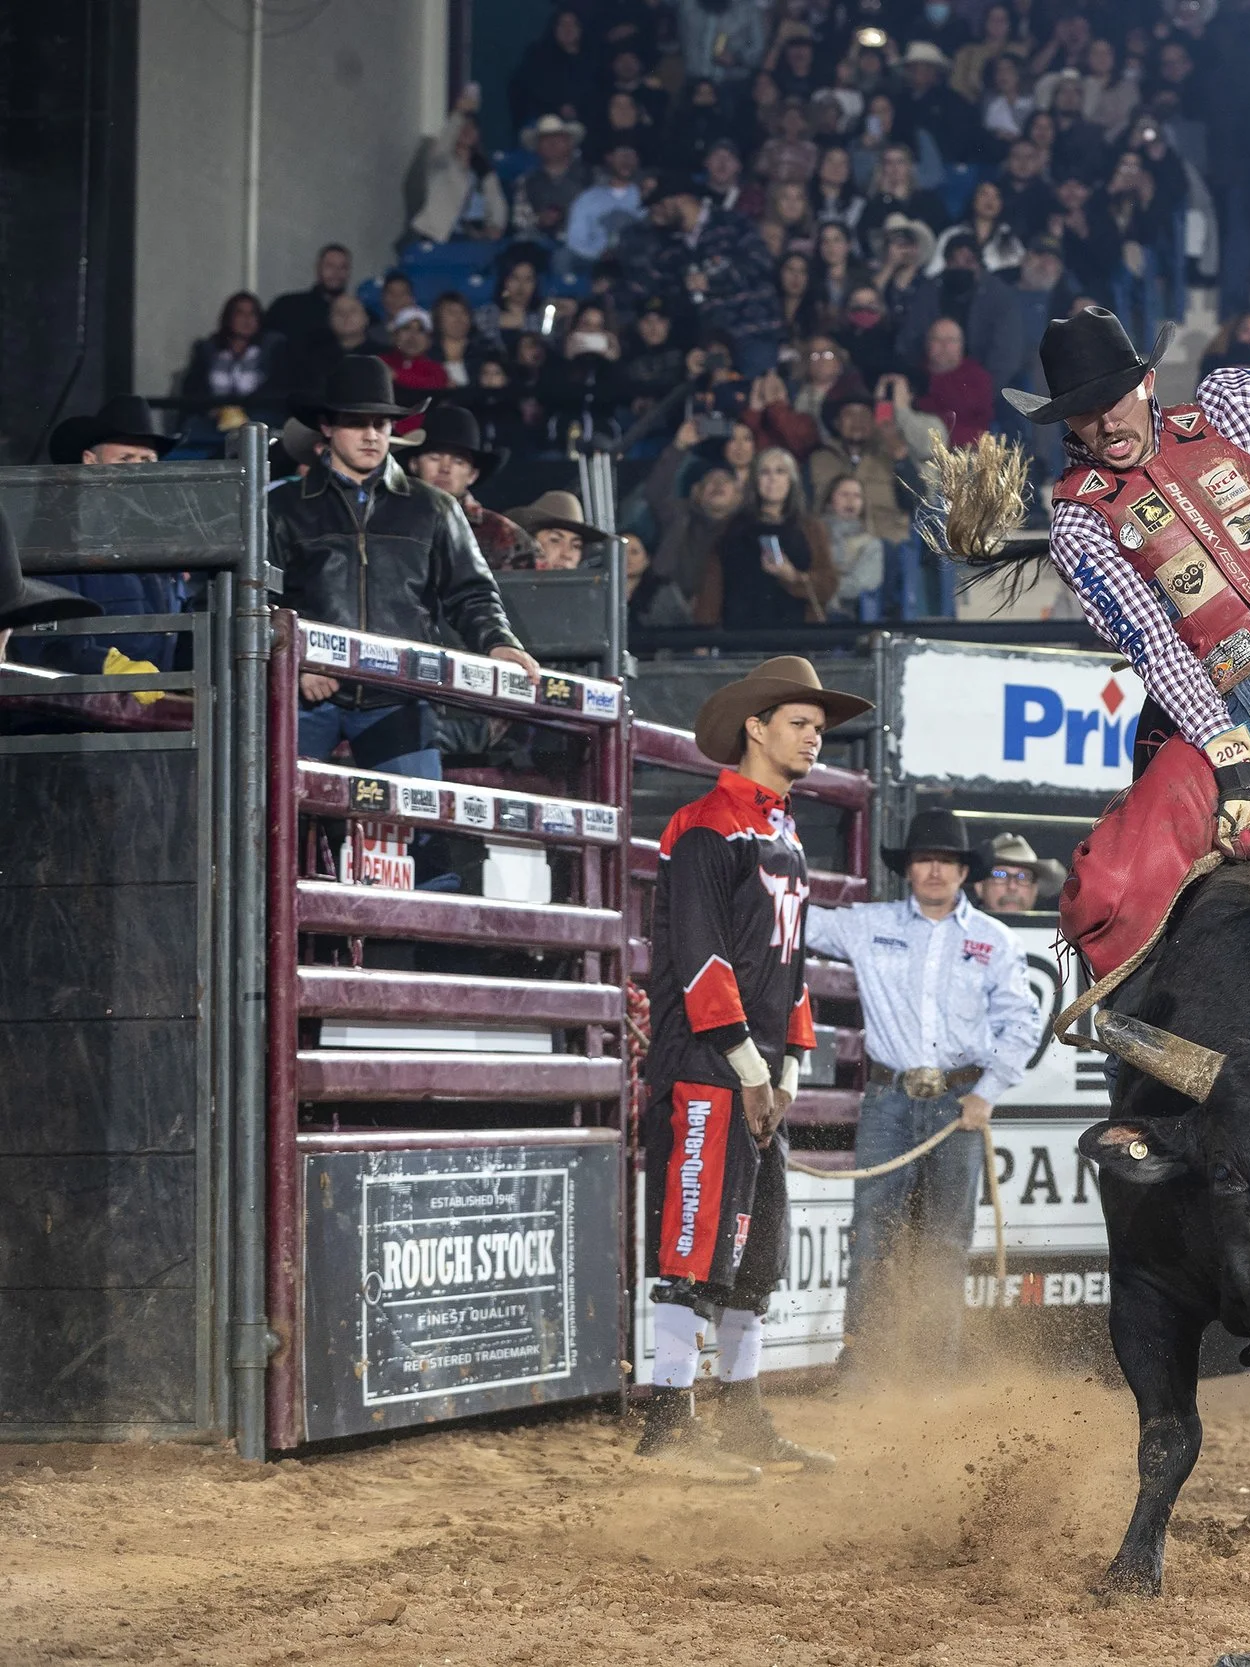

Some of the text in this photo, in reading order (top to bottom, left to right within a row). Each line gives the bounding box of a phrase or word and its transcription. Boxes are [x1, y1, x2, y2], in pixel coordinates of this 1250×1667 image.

[1205, 470, 1238, 498] prca
[1165, 482, 1218, 541] PHOENIX
[1073, 552, 1149, 670] Wrangler
[309, 630, 347, 653] CINCH
[1003, 677, 1137, 767] Pri
[1217, 741, 1250, 763] 2021
[364, 820, 414, 857] UFF
[347, 852, 412, 891] HDEMAN
[676, 1100, 712, 1257] NeverQuitNever
[430, 1194, 493, 1209] ESTABLISHED
[383, 1229, 556, 1291] ROUGH STOCK
[777, 1226, 851, 1291] DLE
[964, 1272, 1110, 1308] UFFHEDE
[417, 1304, 527, 1330] FINEST QUALITY
[403, 1343, 541, 1373] RESTERED TRADEMARK
